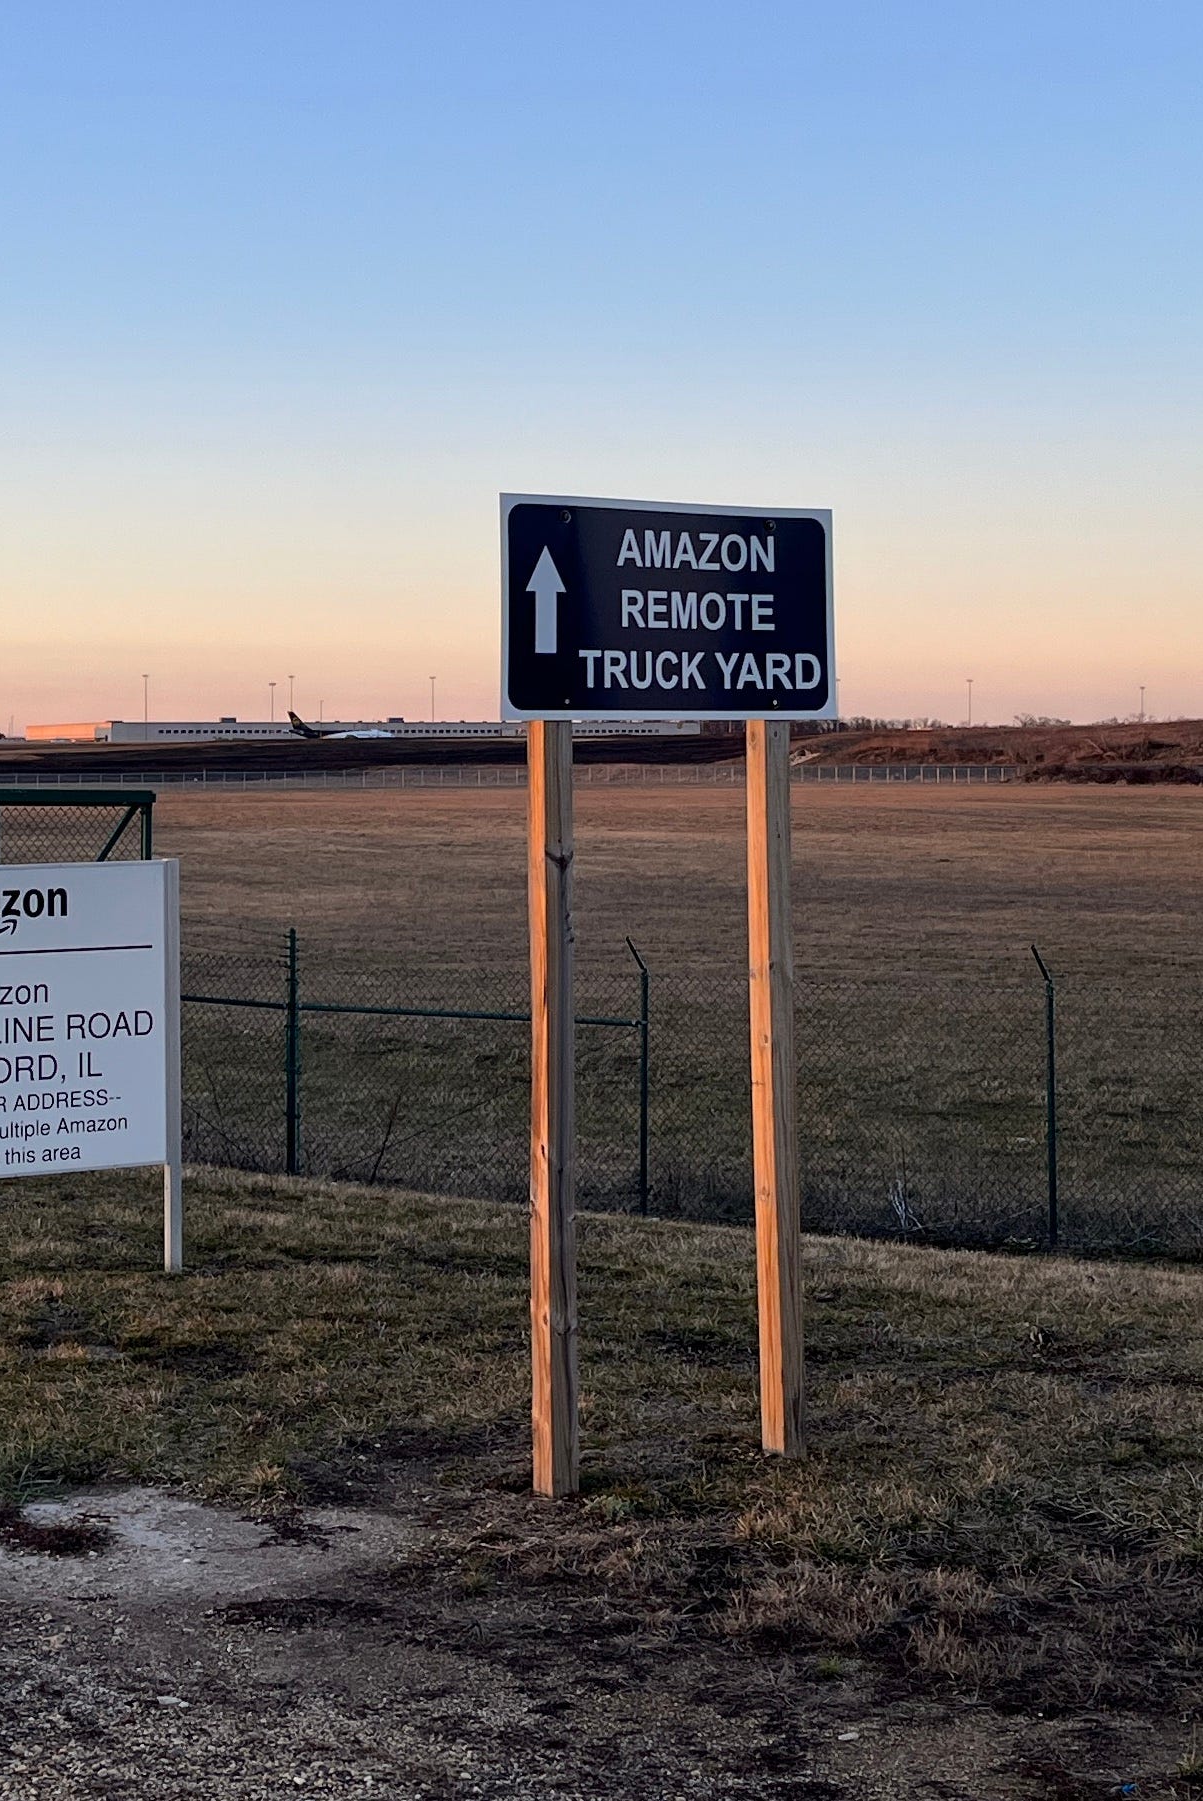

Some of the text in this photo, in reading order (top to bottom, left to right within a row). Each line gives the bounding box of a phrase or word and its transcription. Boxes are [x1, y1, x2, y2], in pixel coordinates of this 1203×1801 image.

[616, 528, 776, 573] AMAZON
[620, 589, 776, 632] REMOTE
[578, 649, 822, 691] TRUCK YARD
[66, 1010, 154, 1041] ROAD
[78, 1051, 103, 1079] IL
[56, 1115, 129, 1135] Amazon
[4, 1147, 36, 1166] this
[41, 1145, 82, 1162] area
